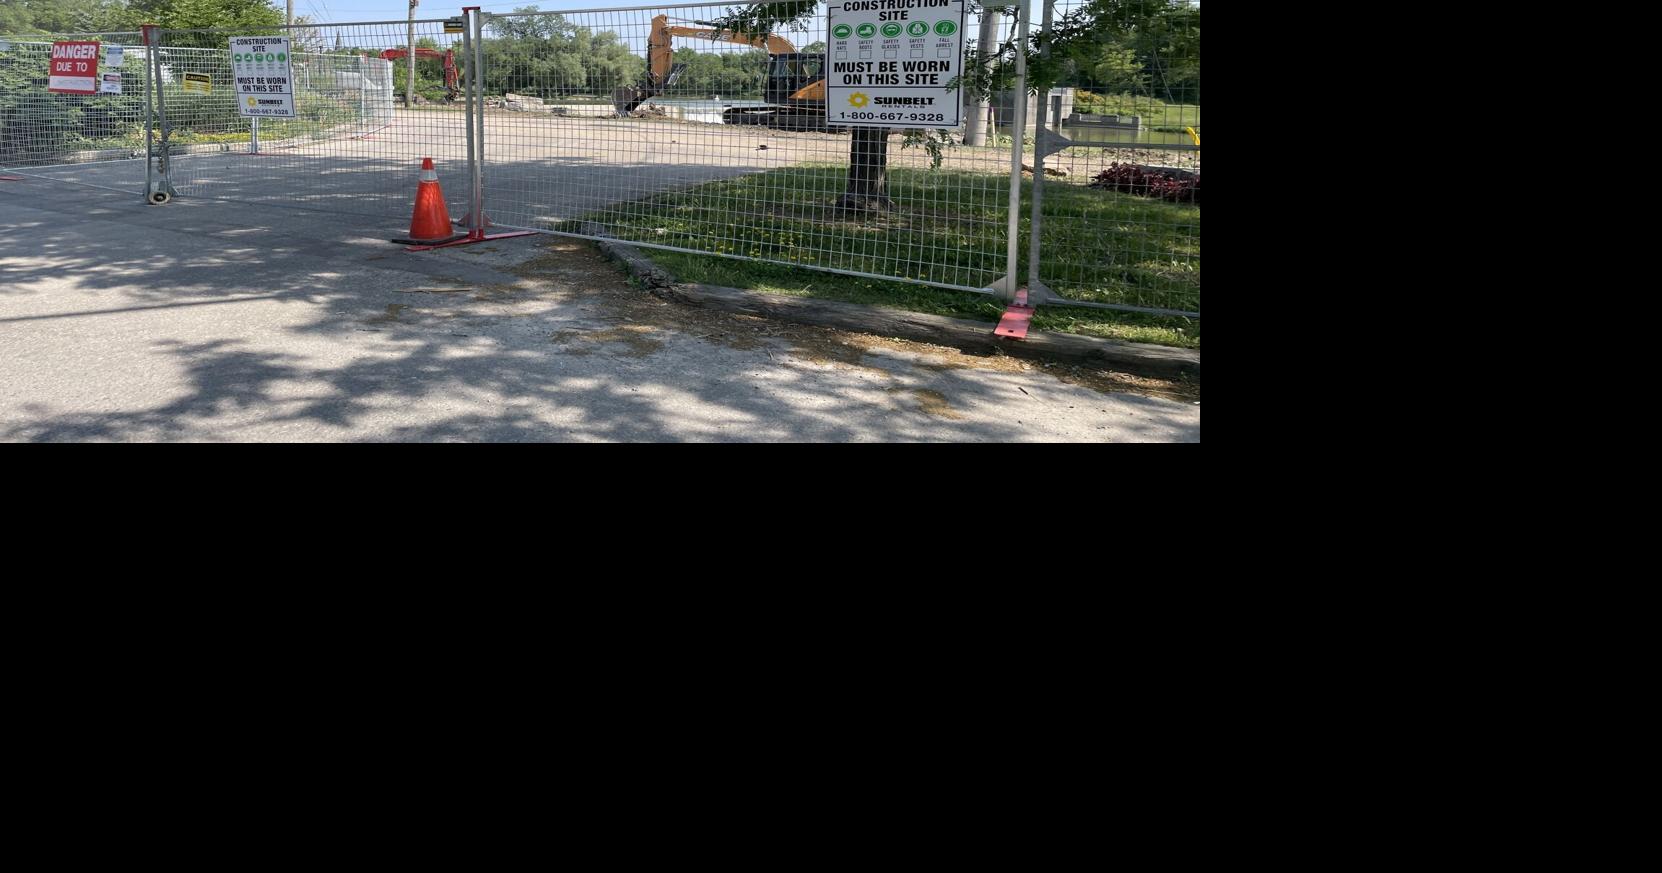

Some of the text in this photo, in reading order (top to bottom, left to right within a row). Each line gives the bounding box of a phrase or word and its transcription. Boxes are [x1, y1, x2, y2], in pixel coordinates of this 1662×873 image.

[843, 0, 949, 12] CONSTRUCTION
[878, 10, 909, 21] SITE
[696, 31, 729, 40] CAE
[236, 38, 282, 46] CONSTRUCTION
[53, 44, 97, 59] DANGER
[56, 62, 88, 72] DUE TO
[834, 60, 950, 73] MUST BE WORN
[843, 73, 939, 85] ON THIS SITE
[873, 96, 935, 105] SUNBELT
[839, 111, 944, 122] 1-800-667-9328
